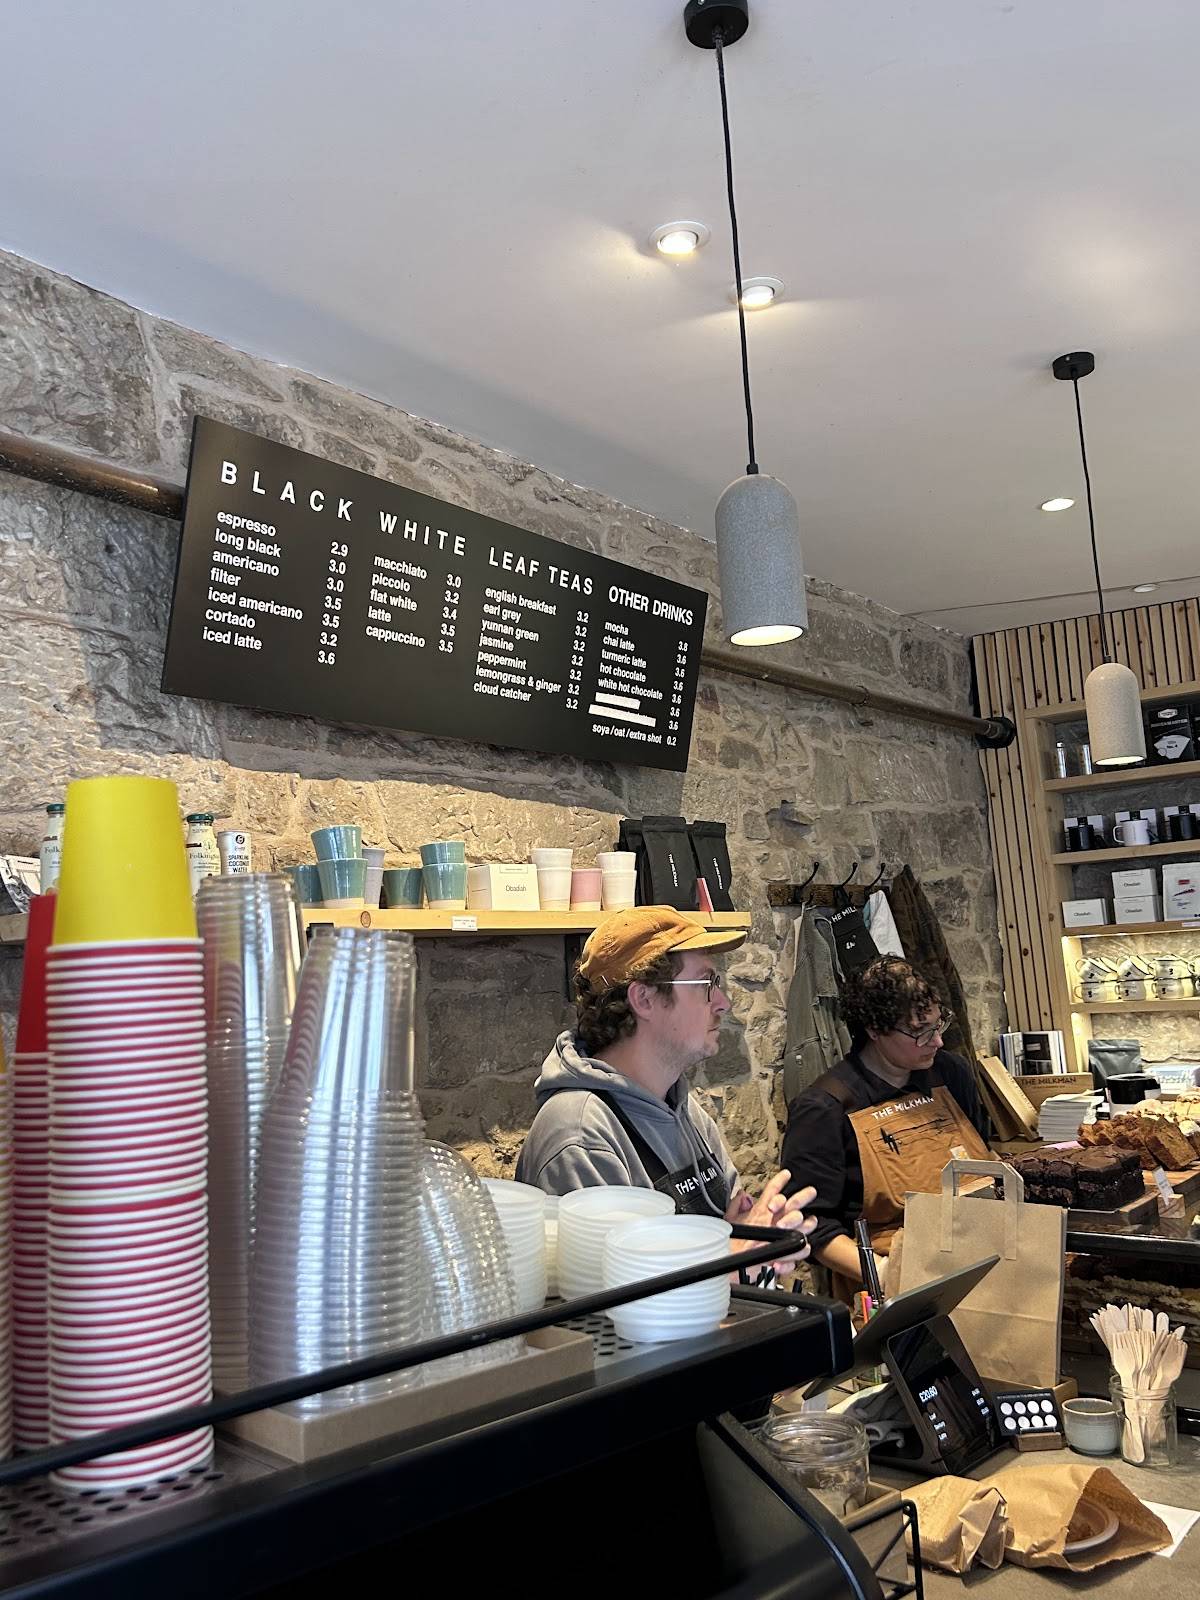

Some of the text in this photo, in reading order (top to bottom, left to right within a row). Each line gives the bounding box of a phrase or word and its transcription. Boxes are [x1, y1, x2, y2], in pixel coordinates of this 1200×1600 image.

[220, 460, 353, 521] BLACK
[217, 511, 348, 557] espresso 2.9
[379, 511, 466, 556] WHITE
[215, 527, 346, 574] long black 3.0
[212, 550, 344, 592] americano 3.0
[373, 556, 461, 588] macchiato 3.0
[489, 546, 592, 595] LEAF TEAS
[210, 567, 342, 610] filter 3.5
[370, 588, 457, 620] flat white 3.4
[371, 572, 459, 604] piccolo 3.2
[208, 586, 340, 628] iced americano 3.5
[368, 605, 455, 637] latte 3.5
[483, 603, 587, 637] earl grey 3.2
[485, 587, 589, 623] english breakfast 3.2
[608, 585, 693, 626] OTHER DRINKS
[205, 608, 337, 647] cortado 3.2
[365, 625, 453, 653] cappuccino 3.5
[481, 619, 585, 652] yunnan green 3.2
[602, 634, 619, 647] chai
[619, 638, 635, 651] latte
[604, 621, 629, 635] mocha
[202, 626, 335, 665] iced latte 3.6
[478, 632, 583, 666] jasmine 3.2
[601, 648, 631, 664] turmeric
[631, 655, 646, 668] latte
[475, 664, 580, 695] lemongrass & ginger 3.2
[477, 651, 582, 681] peppermint 3.2
[599, 662, 612, 674] hot
[612, 666, 646, 682] chocolate
[473, 681, 578, 709] cloud catcher 3.2
[598, 677, 618, 690] white
[618, 681, 630, 693] hot
[630, 684, 663, 700] chocolate
[592, 724, 610, 736] soya
[646, 732, 662, 744] shot
[666, 735, 676, 746] 0.2
[1038, 1076, 1076, 1084] MILKMAN
[871, 1096, 936, 1120] THE MILKMAN
[675, 1178, 696, 1195] THE
